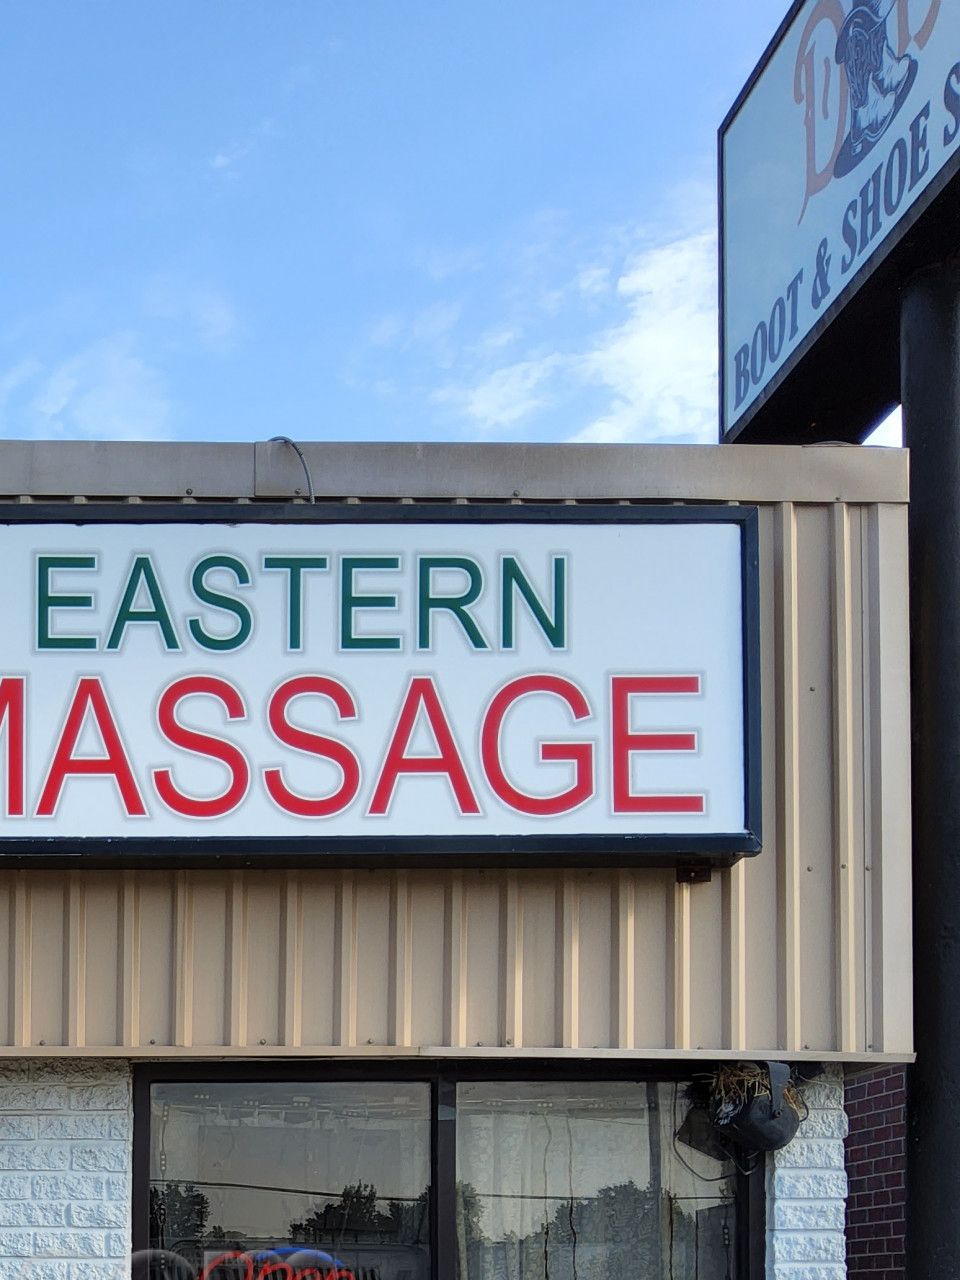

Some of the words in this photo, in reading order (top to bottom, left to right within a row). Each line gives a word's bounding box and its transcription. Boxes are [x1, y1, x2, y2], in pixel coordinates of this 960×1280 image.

[734, 268, 803, 411] BOOT
[811, 237, 831, 311] &
[841, 100, 931, 275] SHOE
[34, 553, 569, 652] EASTERN
